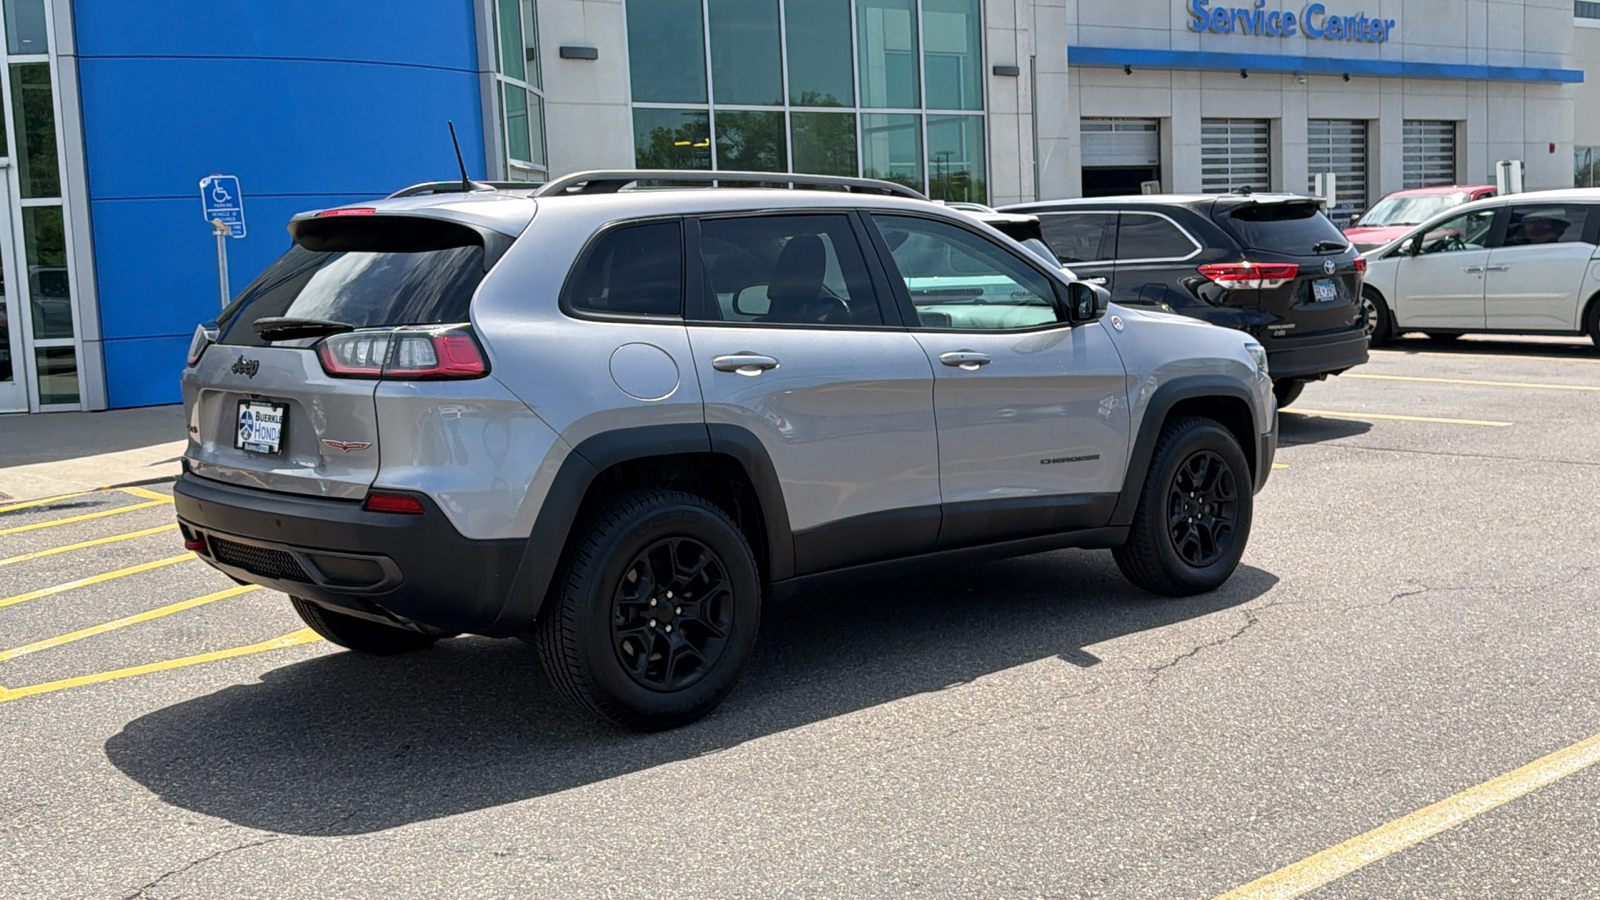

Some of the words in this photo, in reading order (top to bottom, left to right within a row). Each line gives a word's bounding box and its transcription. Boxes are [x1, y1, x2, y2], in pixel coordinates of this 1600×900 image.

[1188, 0, 1297, 37] Service
[1302, 3, 1396, 42] Center
[231, 355, 259, 379] Jeep
[1040, 454, 1100, 464] CHEROKEE
